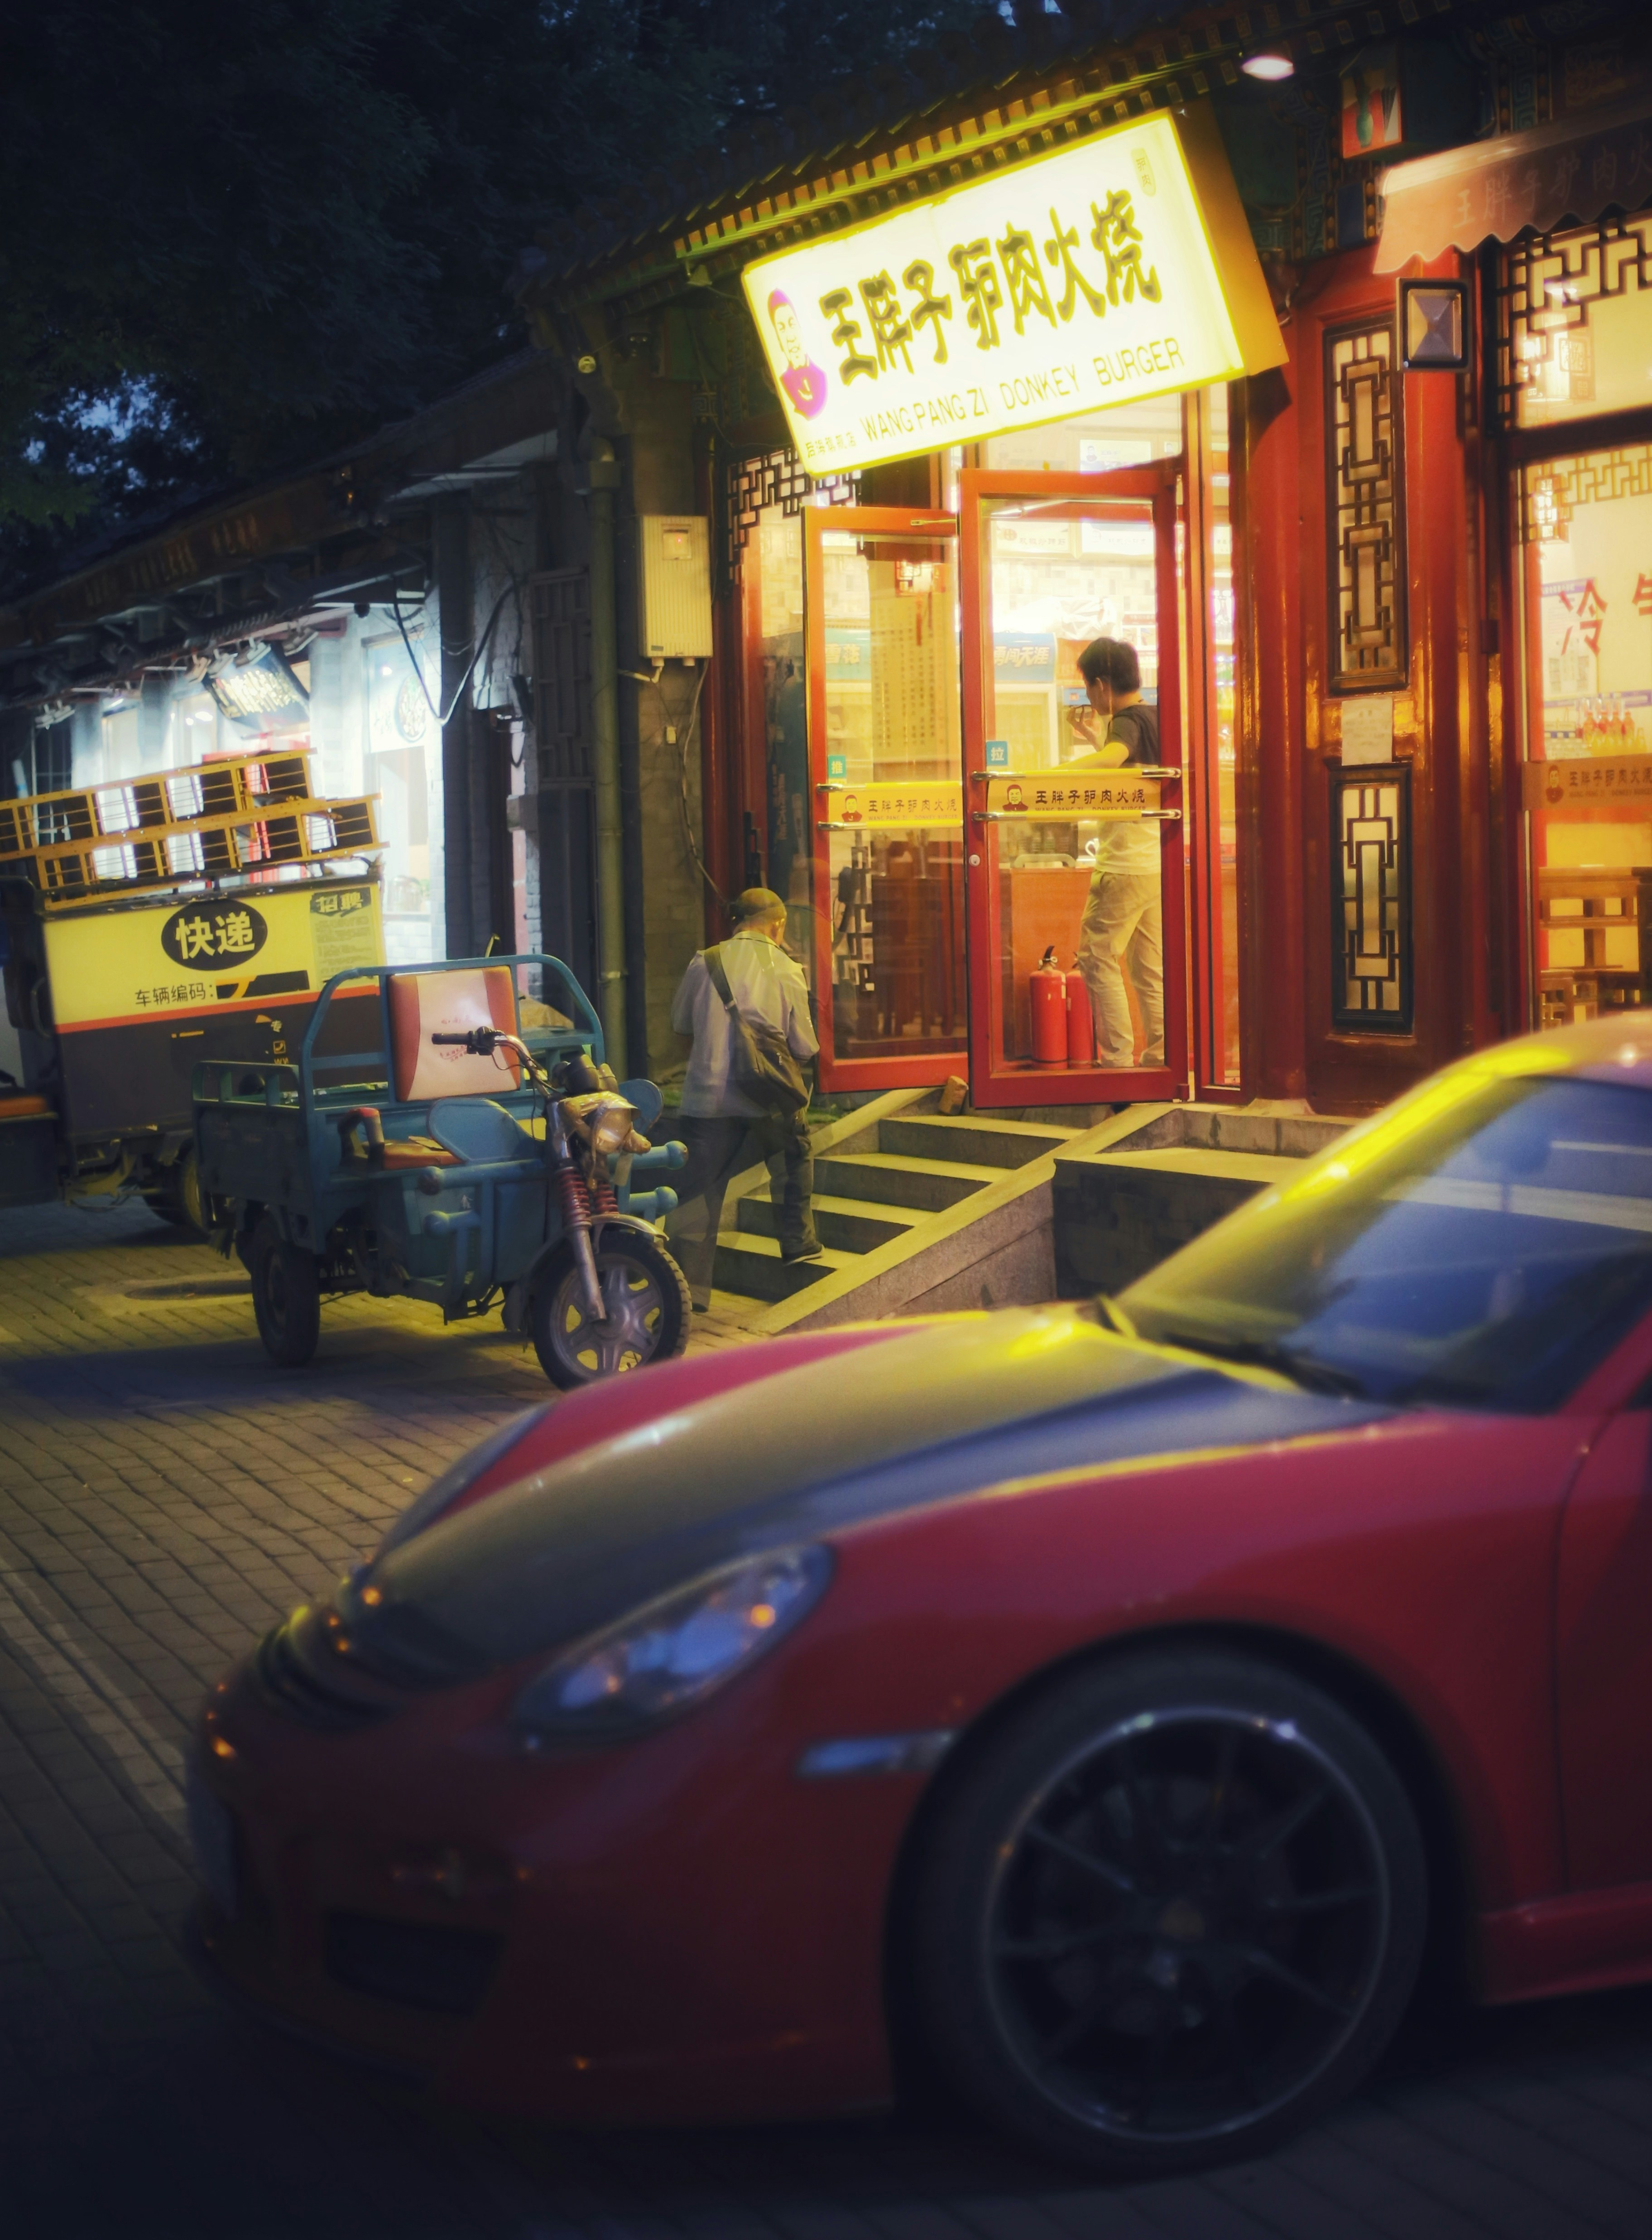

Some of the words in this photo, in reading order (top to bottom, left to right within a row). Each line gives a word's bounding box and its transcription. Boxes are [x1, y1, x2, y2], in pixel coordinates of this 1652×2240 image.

[819, 189, 1161, 385] 王胖子驴肉火烧
[860, 408, 913, 442] WANG
[913, 395, 966, 429] PANG
[966, 387, 989, 417] ZI
[1000, 365, 1081, 409] DONKEY
[1092, 337, 1185, 386] BURGER
[994, 646, 1050, 667] 勇闯天涯
[991, 747, 1004, 761] 拉
[868, 798, 957, 813] 王胖子驴肉火烧
[1035, 789, 1145, 805] 王胖子驴肉火烧
[175, 911, 255, 959] 快递
